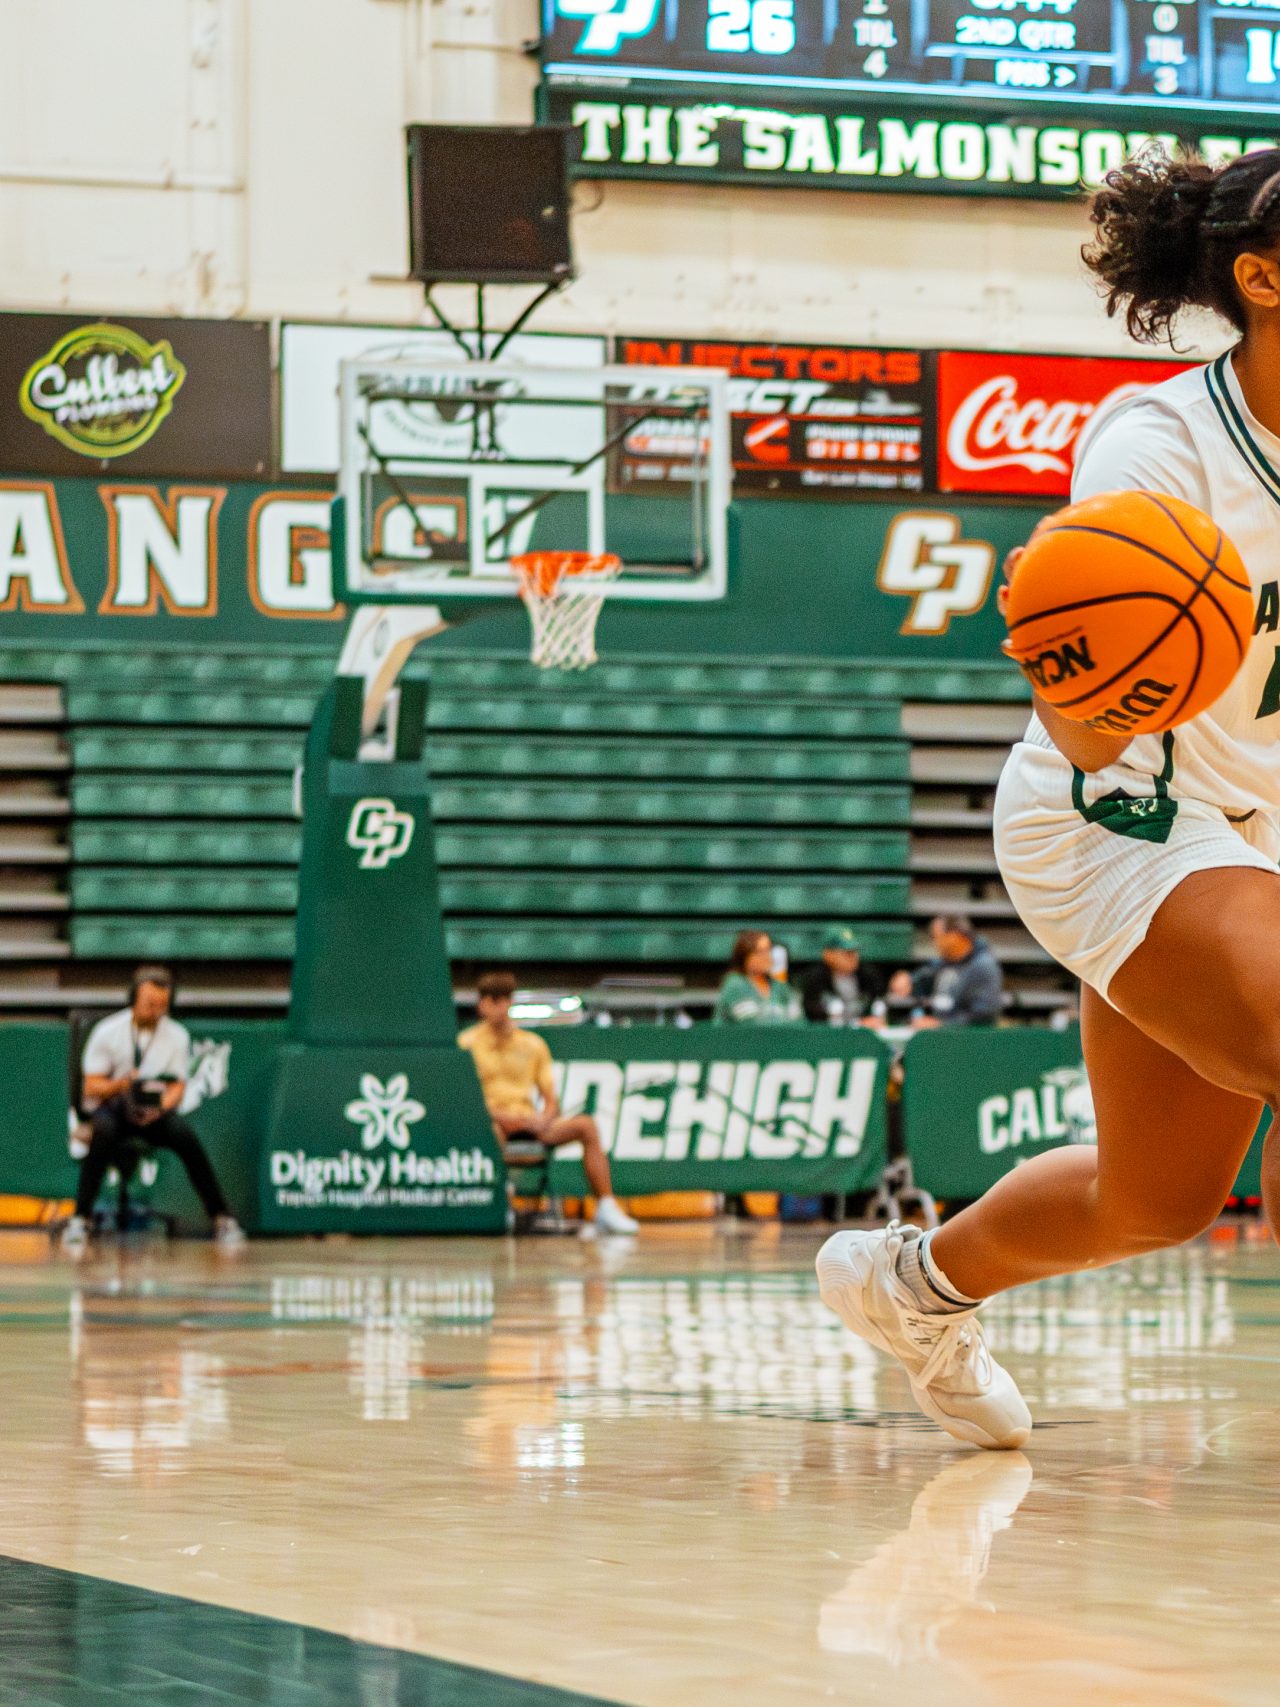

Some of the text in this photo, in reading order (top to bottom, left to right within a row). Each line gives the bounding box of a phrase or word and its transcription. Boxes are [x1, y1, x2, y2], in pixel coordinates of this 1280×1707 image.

[706, 0, 796, 55] 26
[956, 15, 1016, 45] 2ND
[863, 50, 888, 78] 4
[573, 102, 719, 167] THE
[947, 375, 1165, 475] Coca-
[1022, 635, 1097, 688] NCA
[978, 1086, 1067, 1154] CAL
[271, 1148, 495, 1194] Dignity Health
